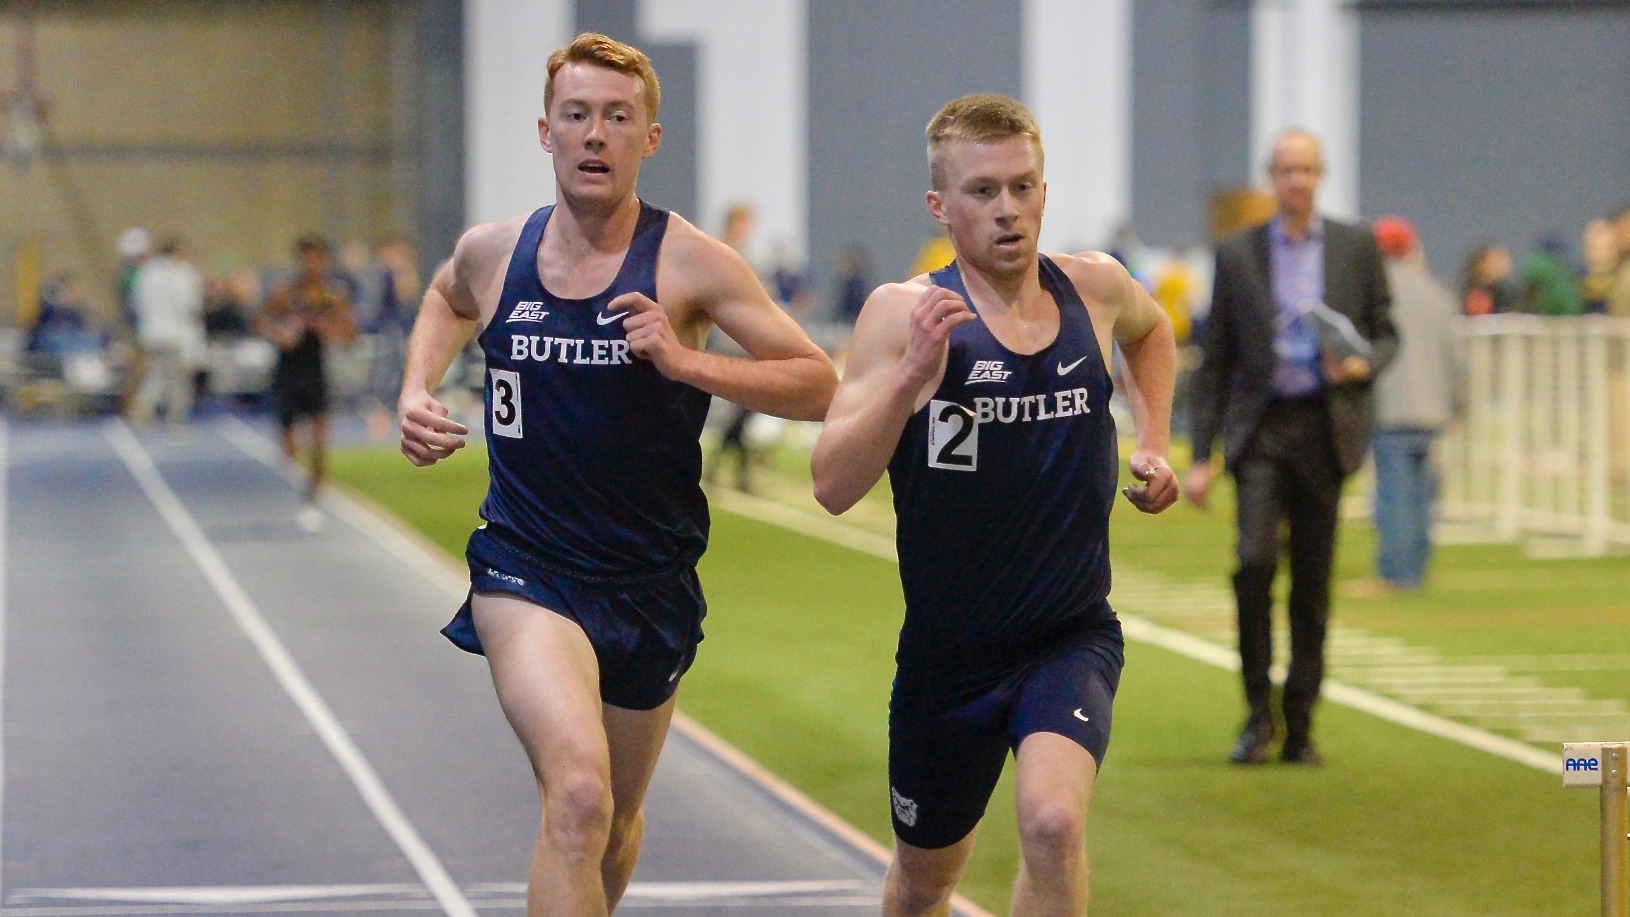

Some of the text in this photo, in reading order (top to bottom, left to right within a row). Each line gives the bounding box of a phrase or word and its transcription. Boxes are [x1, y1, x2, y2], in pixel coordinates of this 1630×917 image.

[508, 311, 550, 320] EAST
[514, 301, 544, 311] BIG
[510, 335, 632, 365] BUTLER
[968, 370, 1013, 380] EAST
[974, 360, 1005, 370] BIG
[494, 379, 516, 426] 3
[973, 387, 1092, 424] BUTLER
[936, 404, 974, 466] 2
